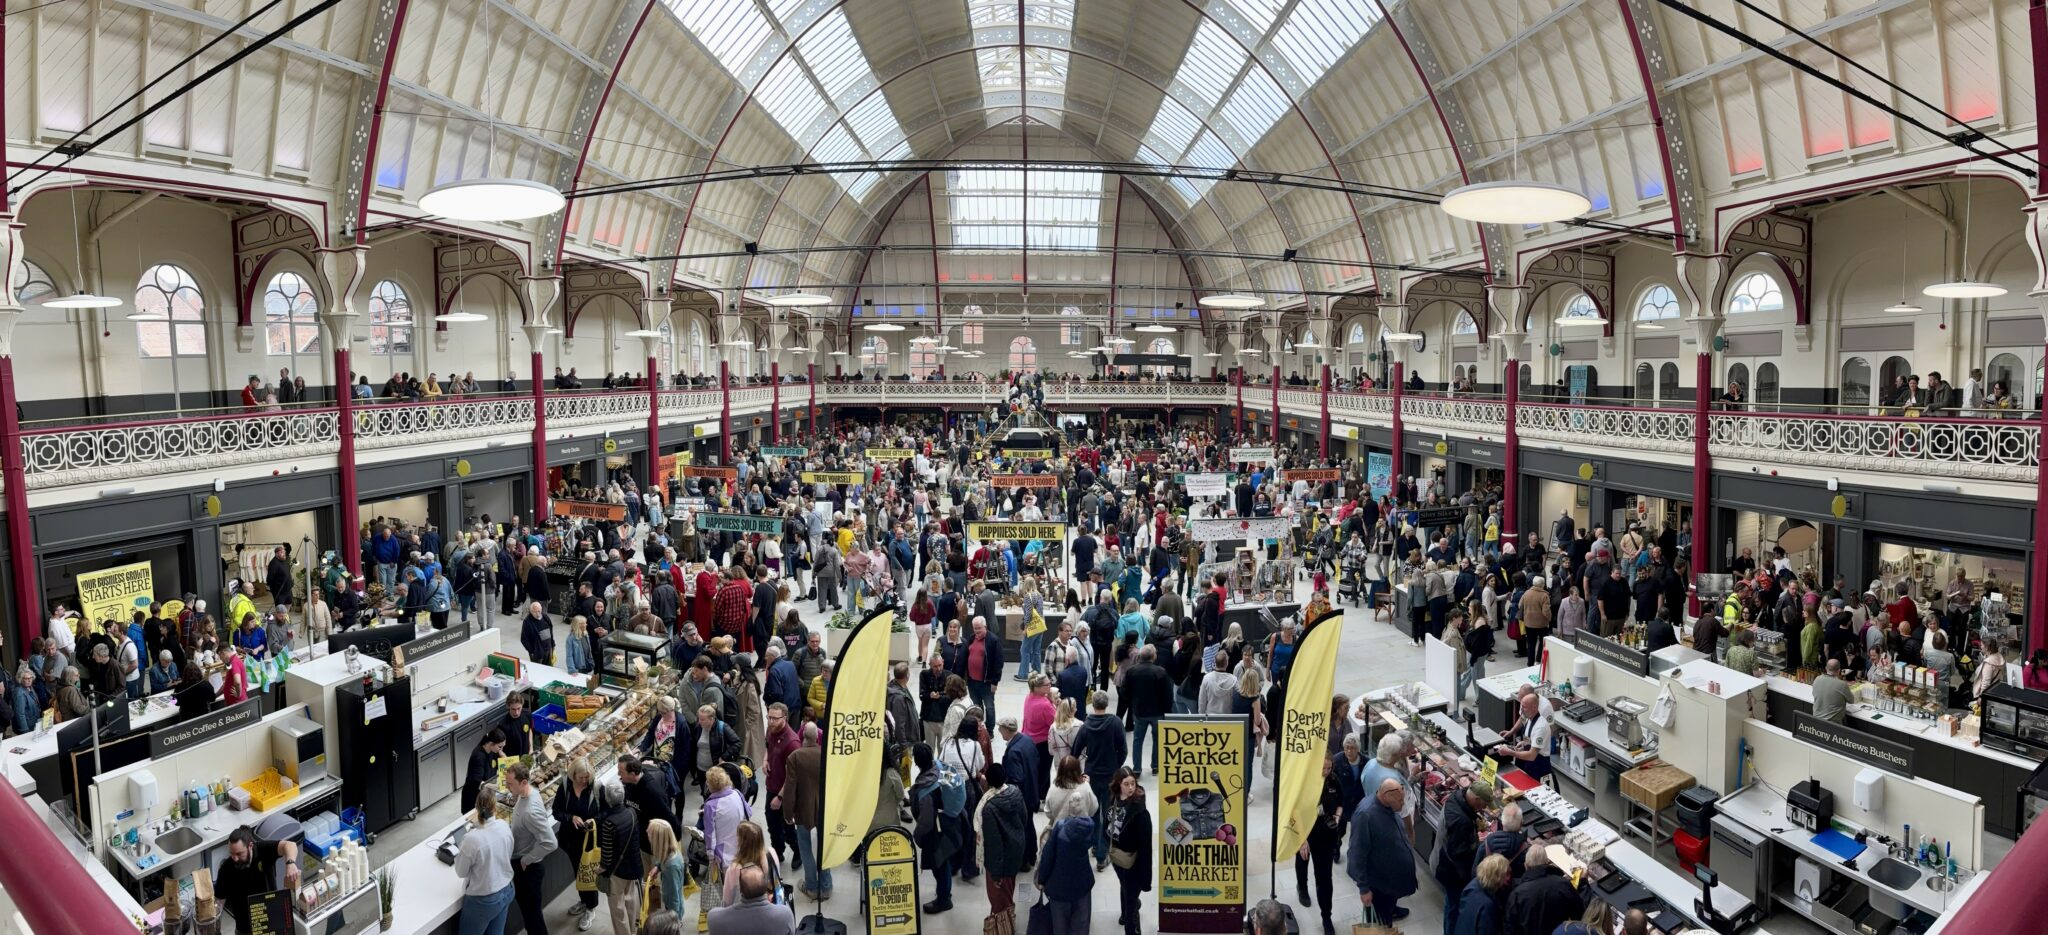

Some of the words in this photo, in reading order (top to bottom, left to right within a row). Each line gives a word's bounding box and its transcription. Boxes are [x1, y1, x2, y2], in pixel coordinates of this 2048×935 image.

[829, 475, 851, 483] YOURSELF
[994, 476, 1013, 485] LOCALLY
[1014, 476, 1034, 485] CRAFTED
[1036, 476, 1055, 485] GOODIES
[1288, 472, 1311, 480] HAPPINESS
[1325, 471, 1335, 479] HERE
[570, 505, 594, 517] LOVINGLY
[595, 506, 609, 518] MADE
[706, 517, 740, 530] HAPPINESS
[741, 519, 757, 531] SOLD
[759, 520, 774, 532] HERE
[978, 526, 1017, 538] HAPPINESS
[1019, 526, 1037, 538] SOLD
[1038, 527, 1056, 538] HERE
[81, 578, 97, 591] YOUR
[98, 573, 125, 587] BUSINESS
[125, 568, 149, 582] GROWTH
[82, 584, 122, 603] STARTS
[123, 578, 151, 595] HERE
[427, 638, 442, 648] Coffee
[447, 631, 463, 641] Bakery
[1578, 638, 1597, 651] Anthony
[1598, 646, 1620, 660] Andrews
[1620, 654, 1640, 668] Butchers
[833, 711, 877, 726] Derby
[1287, 709, 1326, 726] Derby
[163, 731, 191, 746] Olivia's
[192, 722, 217, 736] Coffee
[218, 719, 224, 727] &
[225, 709, 251, 724] Bakery
[832, 724, 881, 741] Market
[1286, 723, 1327, 741] Market
[831, 739, 861, 755] Hall
[1163, 727, 1231, 750] Derby
[1285, 737, 1312, 753] Hall
[1798, 722, 1831, 742] Anthony
[1832, 735, 1869, 754] Andrews
[1870, 746, 1907, 766] Butchers
[1163, 747, 1239, 765] Market
[1163, 766, 1208, 784] Hall
[1163, 844, 1201, 865] MORE
[1203, 844, 1239, 866] THAN
[1164, 866, 1174, 880] A
[1178, 866, 1239, 881] MARKET
[889, 884, 912, 895] VOUCHER
[878, 895, 884, 905] TO
[885, 894, 901, 904] SPEND
[902, 894, 908, 902] AT
